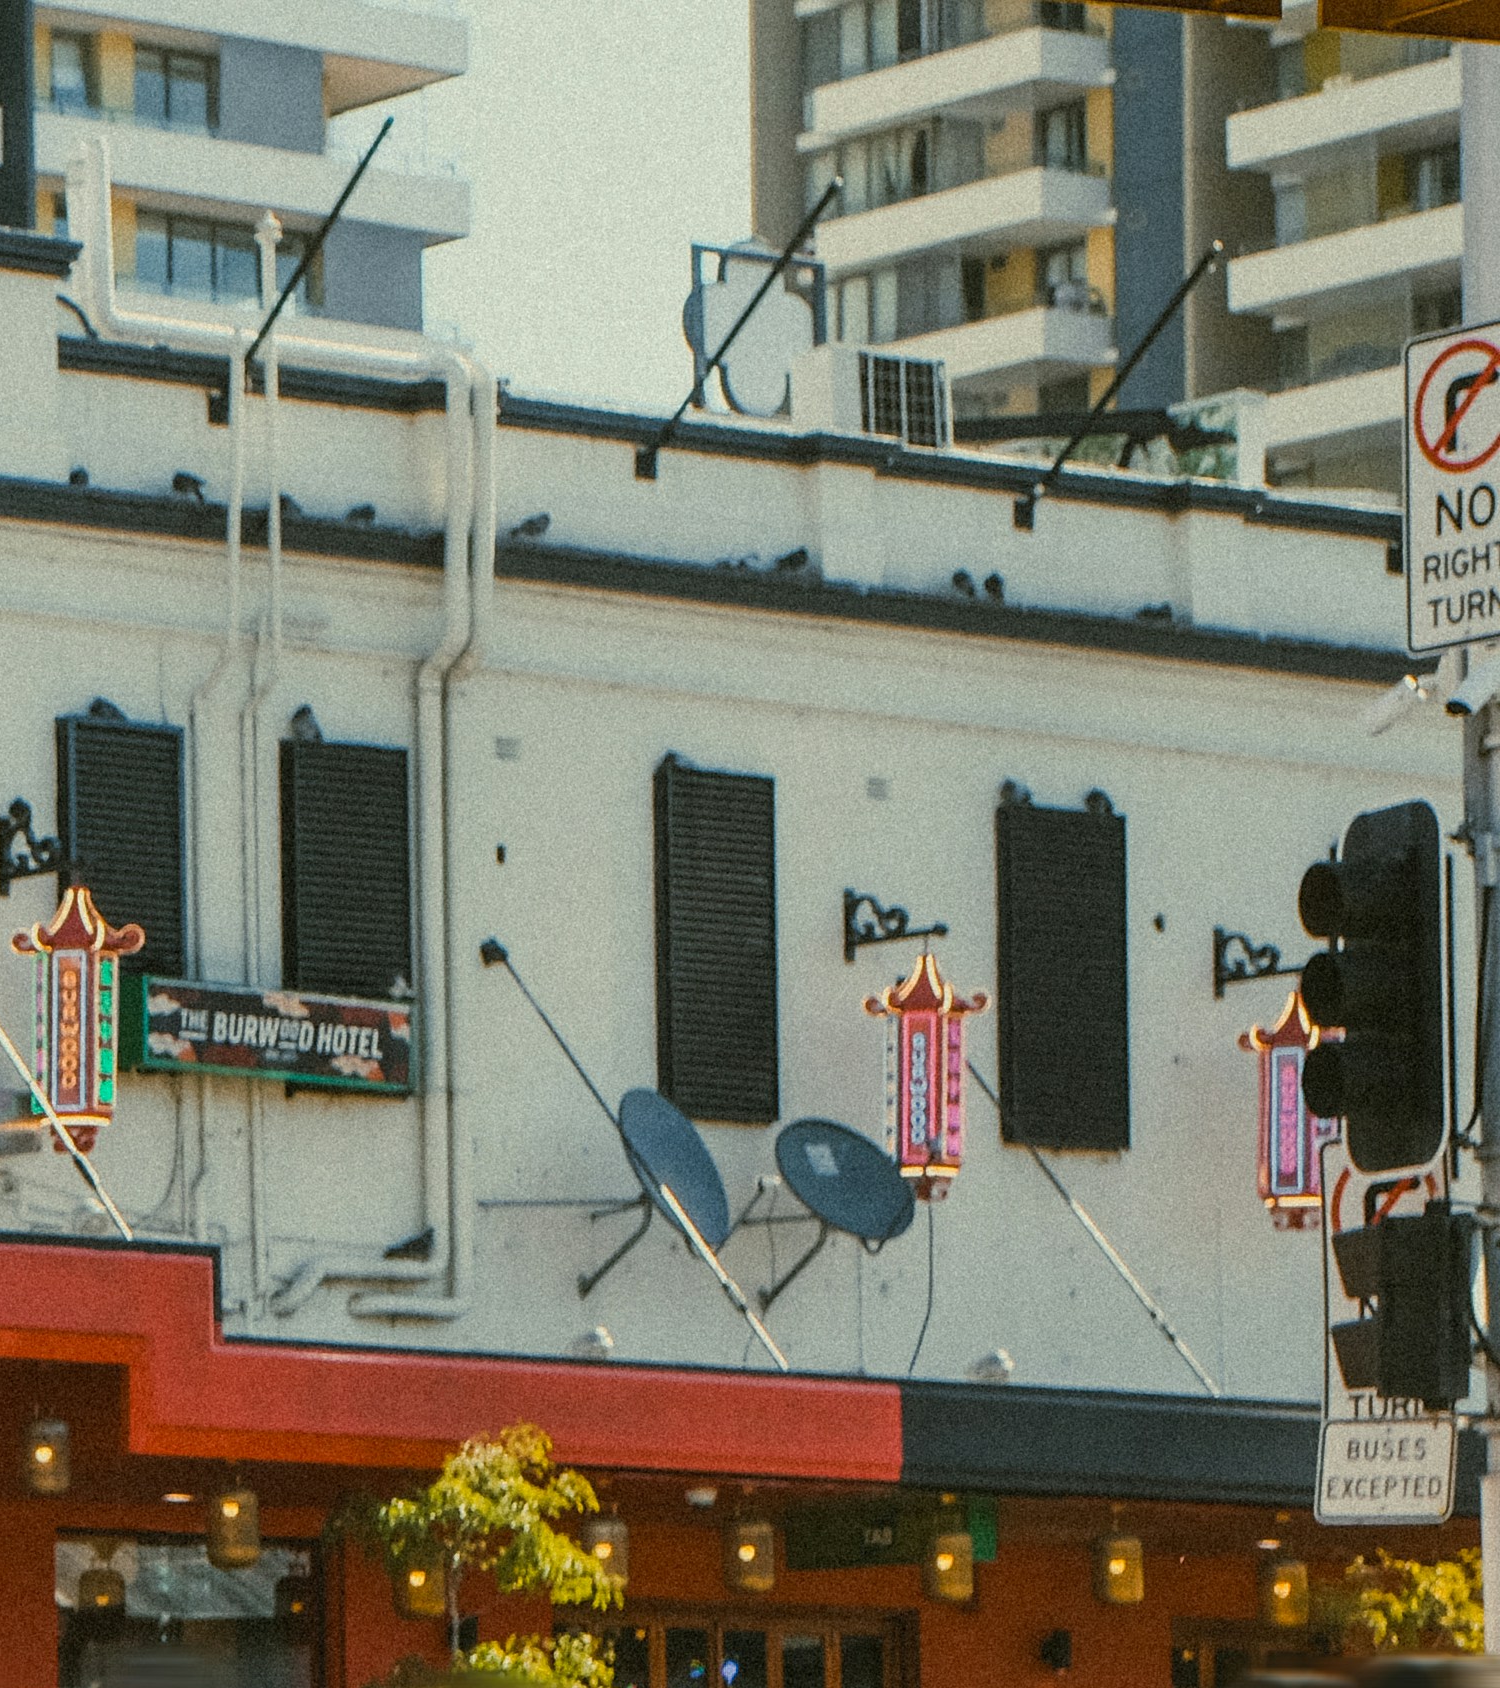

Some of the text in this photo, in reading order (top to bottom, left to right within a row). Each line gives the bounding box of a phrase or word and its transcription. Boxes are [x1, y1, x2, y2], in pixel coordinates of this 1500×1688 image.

[1435, 483, 1497, 537] NO
[181, 1008, 384, 1060] THE BURWOOD HOTEL
[1347, 1436, 1427, 1461] BUSES
[1326, 1475, 1443, 1500] EXCEPTED
